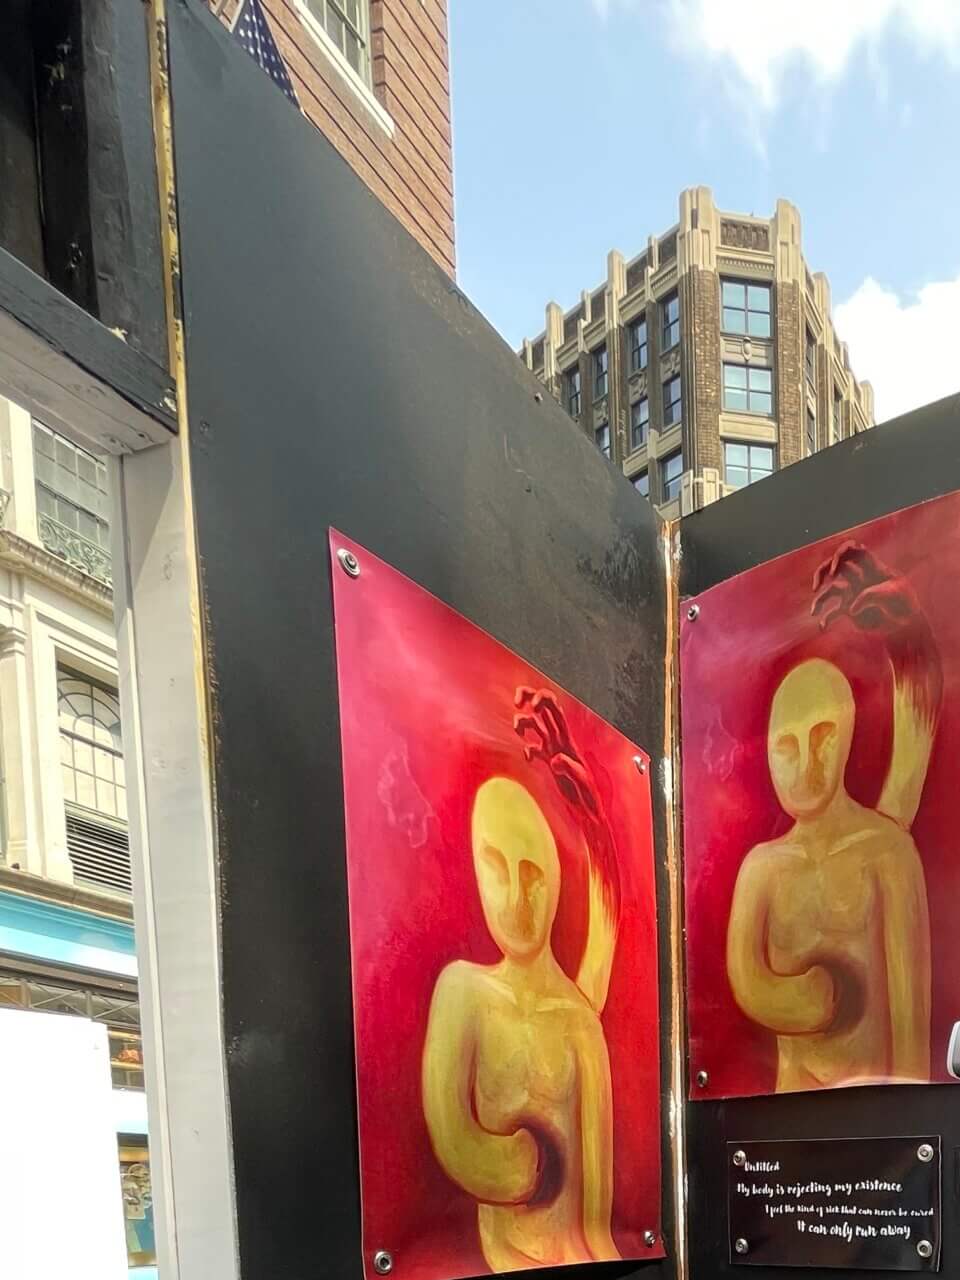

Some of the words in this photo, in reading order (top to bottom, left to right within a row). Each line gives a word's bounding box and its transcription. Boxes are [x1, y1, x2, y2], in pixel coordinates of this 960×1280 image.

[744, 1161, 781, 1172] Untitled
[737, 1182, 750, 1197] My
[752, 1183, 774, 1198] body
[776, 1183, 785, 1195] is
[787, 1181, 832, 1198] rejecting
[834, 1182, 852, 1196] my
[855, 1179, 903, 1192] existence
[797, 1220, 806, 1232] It
[808, 1224, 828, 1235] can
[830, 1221, 853, 1242] only
[855, 1225, 877, 1237] run
[879, 1225, 911, 1240] away
